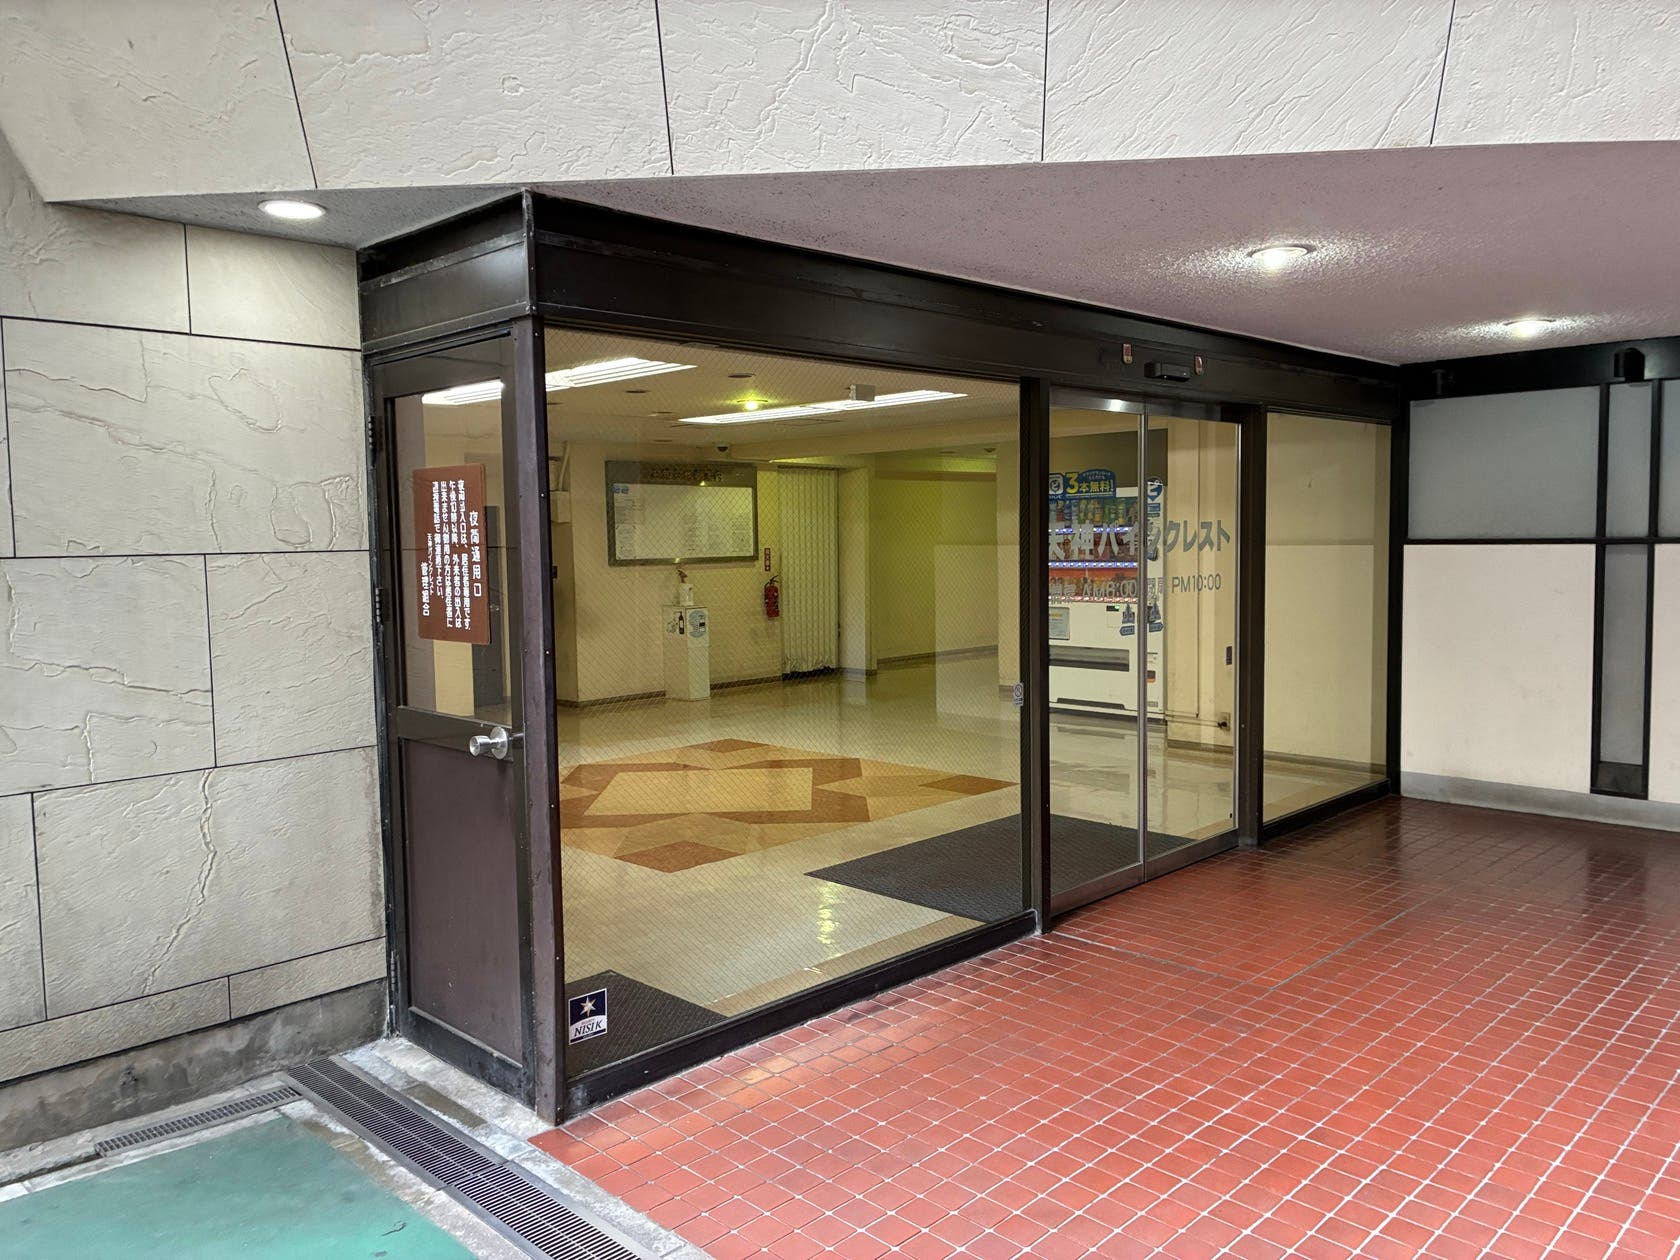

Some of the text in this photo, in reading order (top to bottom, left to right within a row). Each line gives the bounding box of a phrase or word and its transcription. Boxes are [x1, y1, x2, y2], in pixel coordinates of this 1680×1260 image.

[469, 511, 482, 597] 夜間通用口
[1172, 573, 1222, 593] PM10:00
